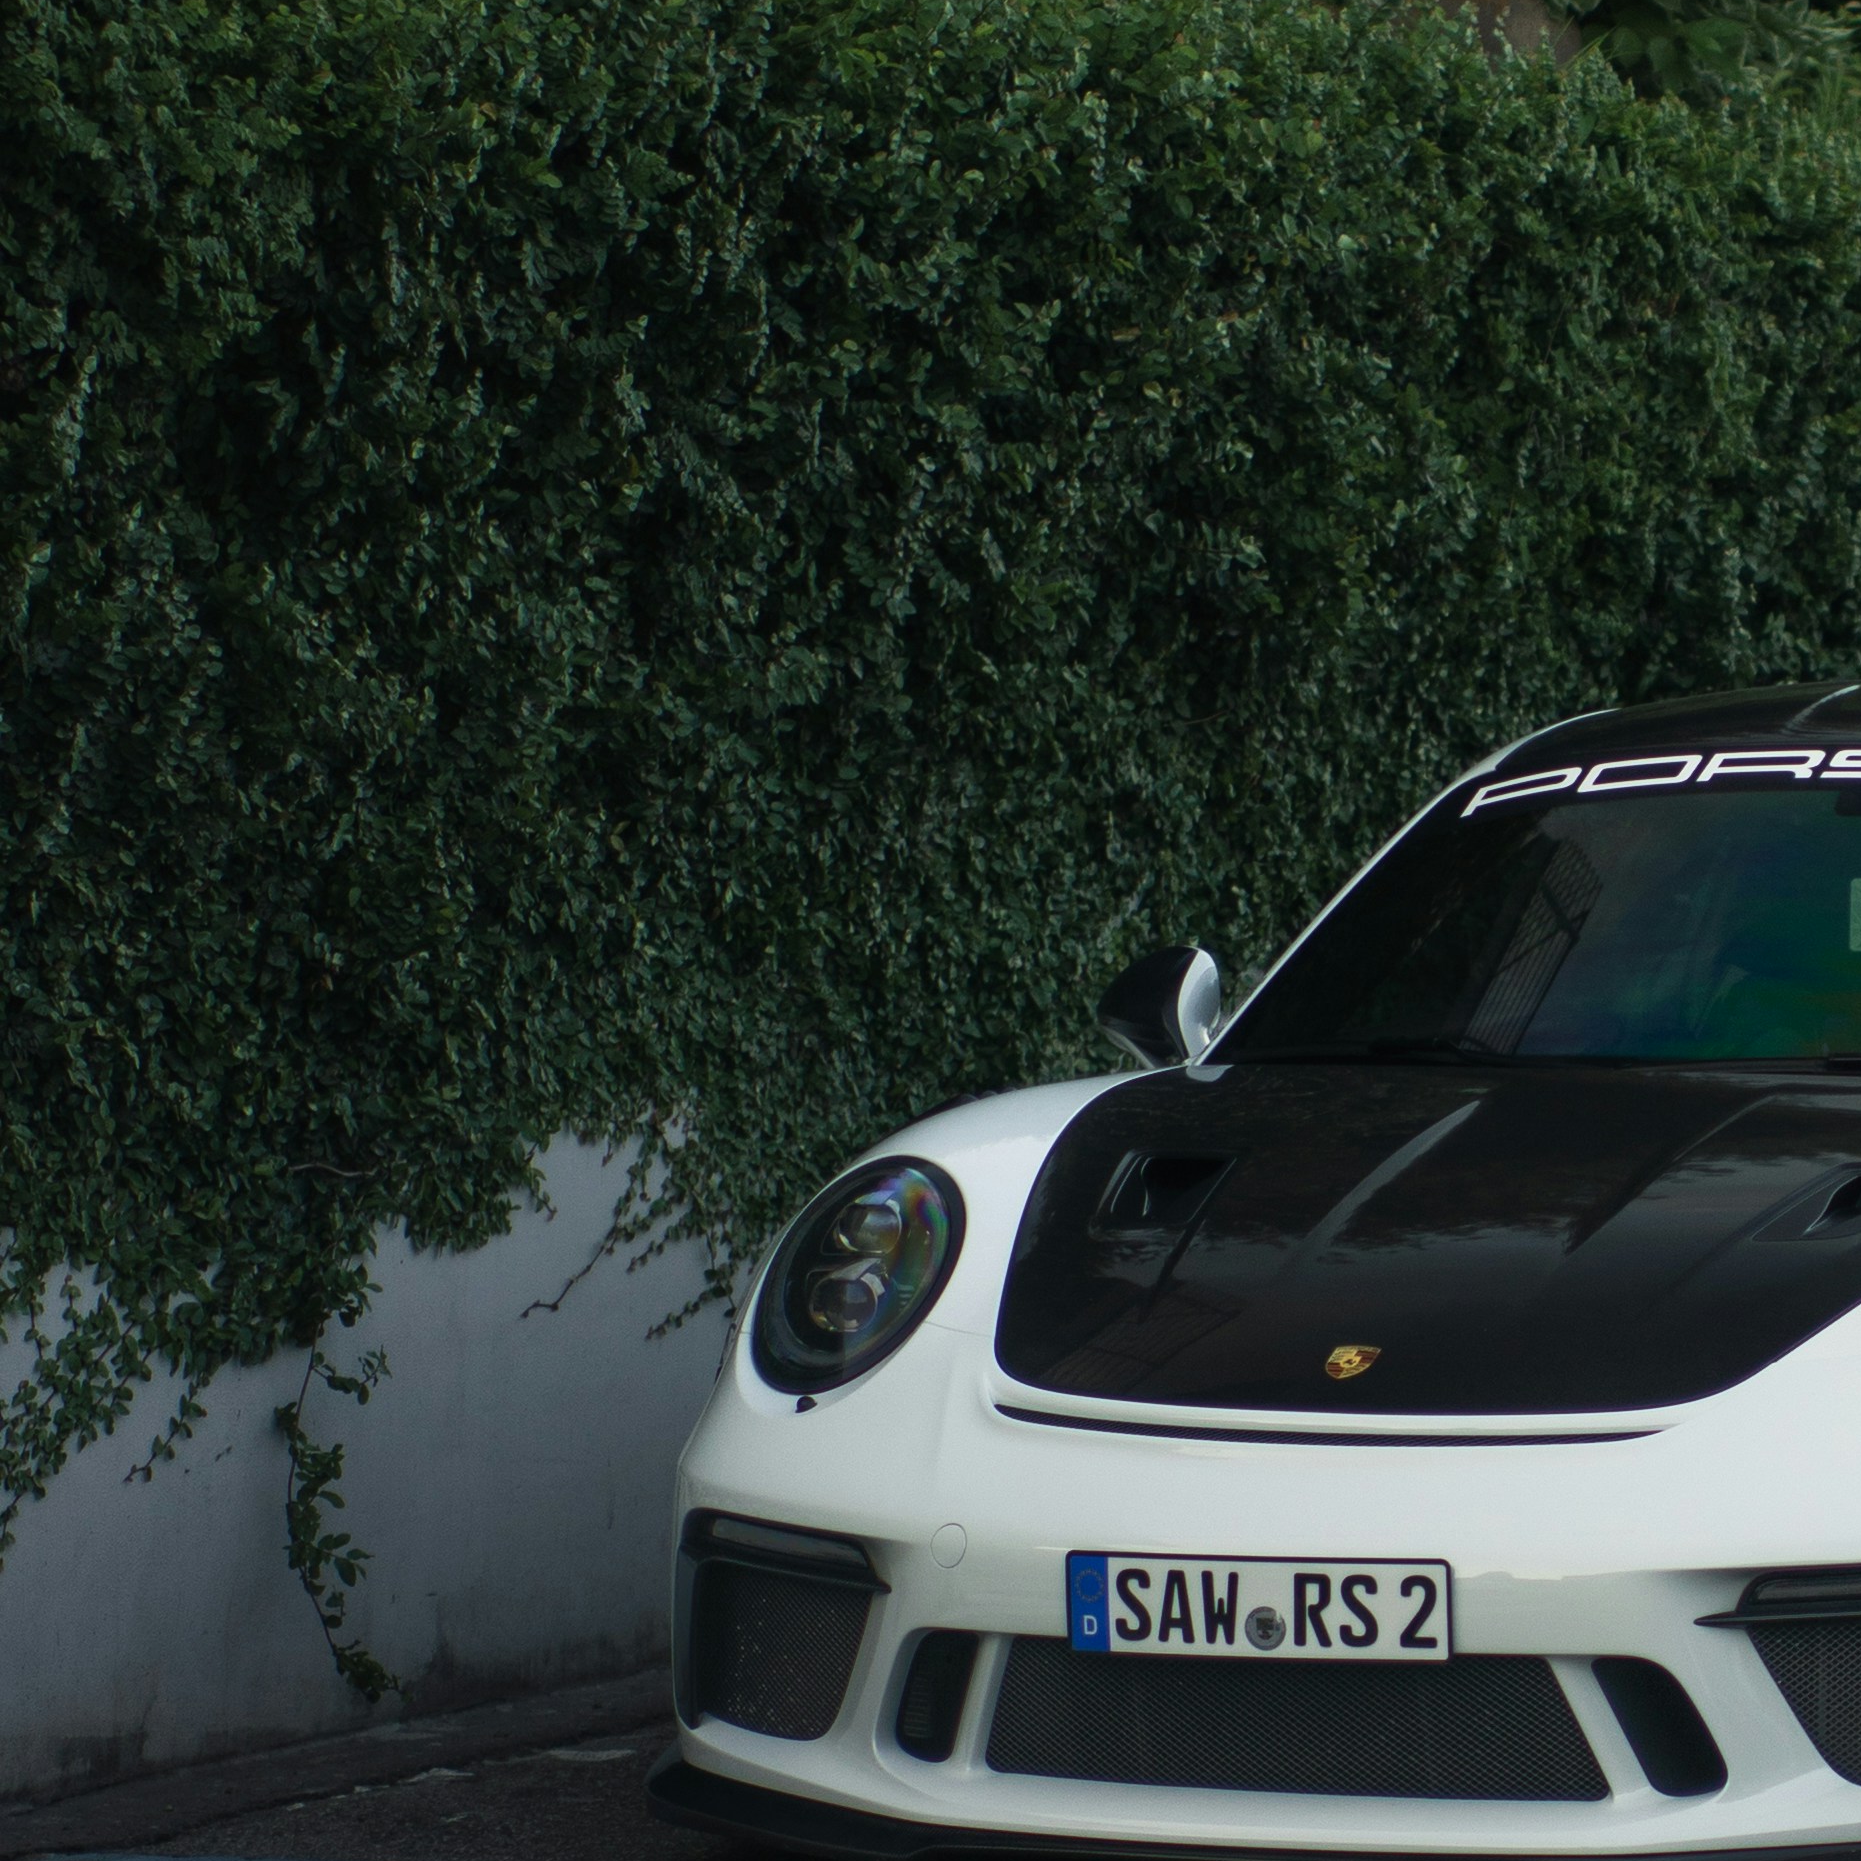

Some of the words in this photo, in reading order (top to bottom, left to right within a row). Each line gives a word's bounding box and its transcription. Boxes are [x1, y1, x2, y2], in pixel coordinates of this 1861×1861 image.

[1083, 1614, 1098, 1636] D
[1115, 1568, 1240, 1646] SAW
[1293, 1572, 1379, 1649] RS
[1400, 1574, 1438, 1649] 2
